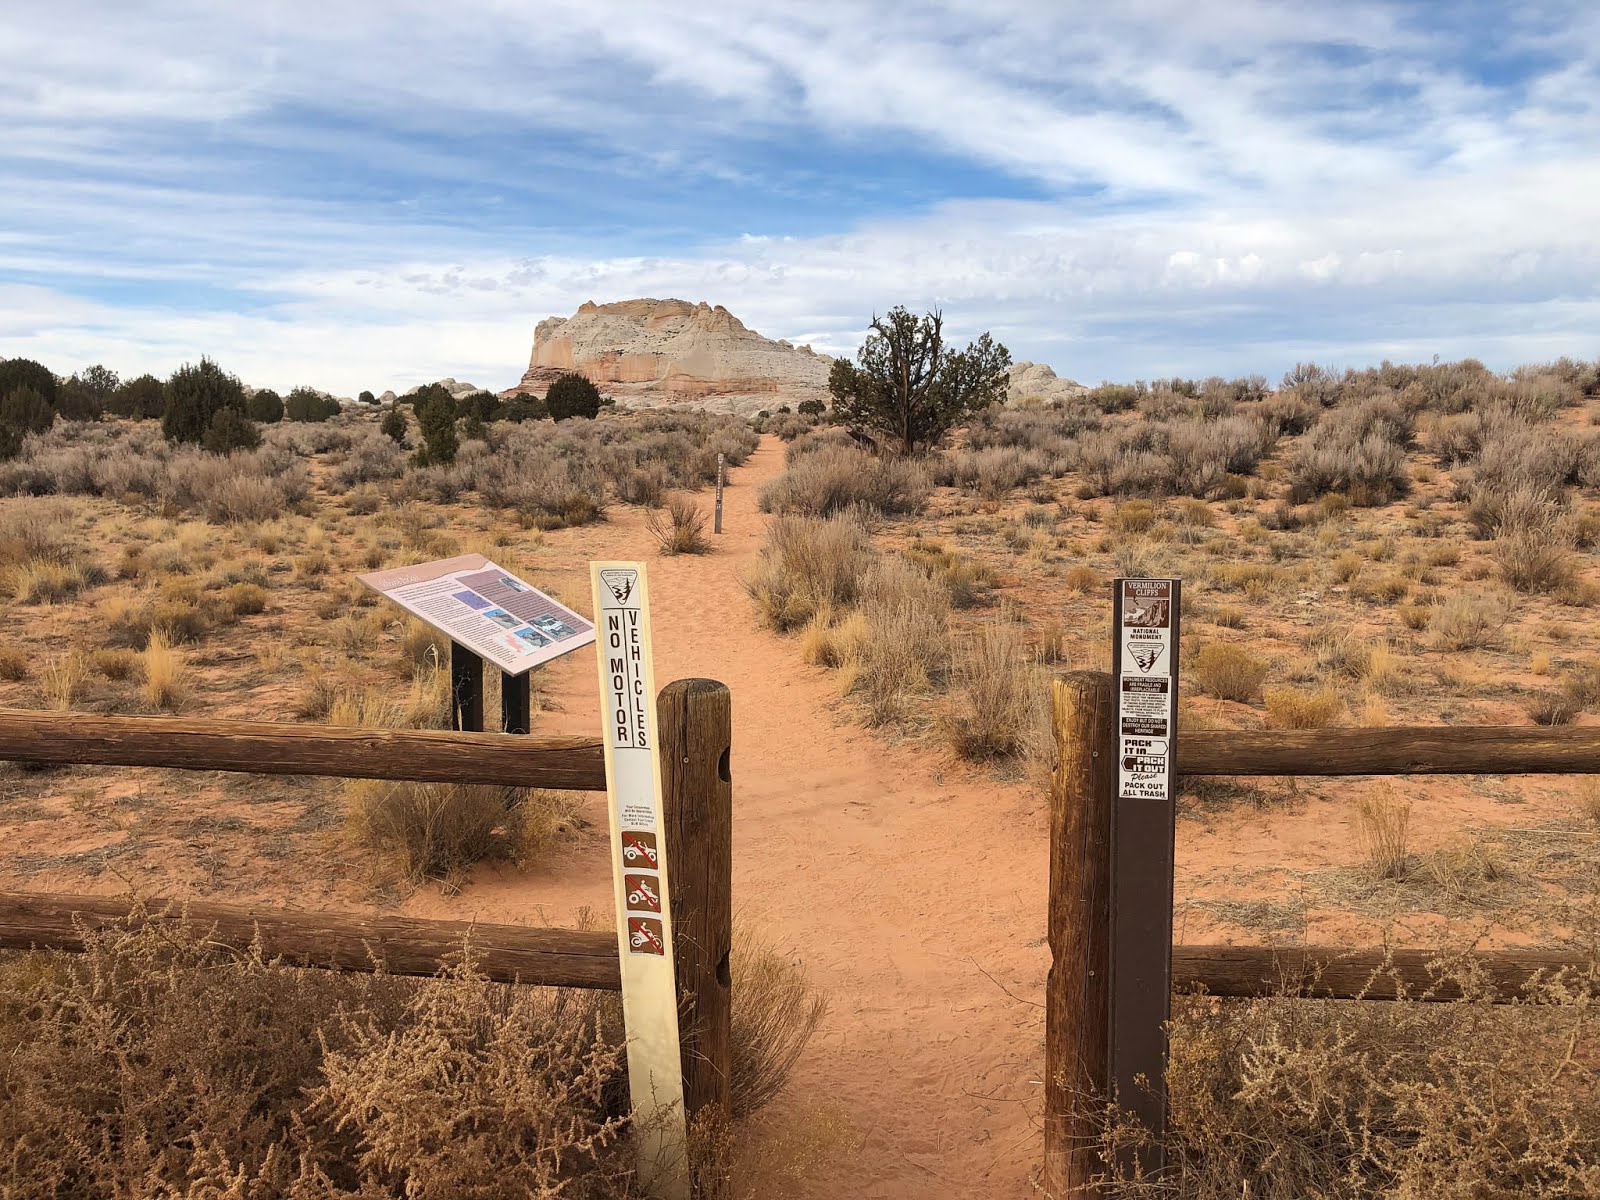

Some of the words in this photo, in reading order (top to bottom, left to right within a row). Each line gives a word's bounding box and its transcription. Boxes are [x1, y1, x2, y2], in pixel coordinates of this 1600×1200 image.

[608, 615, 620, 648] NO
[628, 610, 646, 746] VEHICLES
[610, 658, 627, 741] MOTOR
[1124, 739, 1152, 747] PACK
[1136, 756, 1164, 765] PACK
[1132, 764, 1143, 772] IT
[1144, 765, 1165, 773] OUT
[1131, 773, 1157, 781] Please
